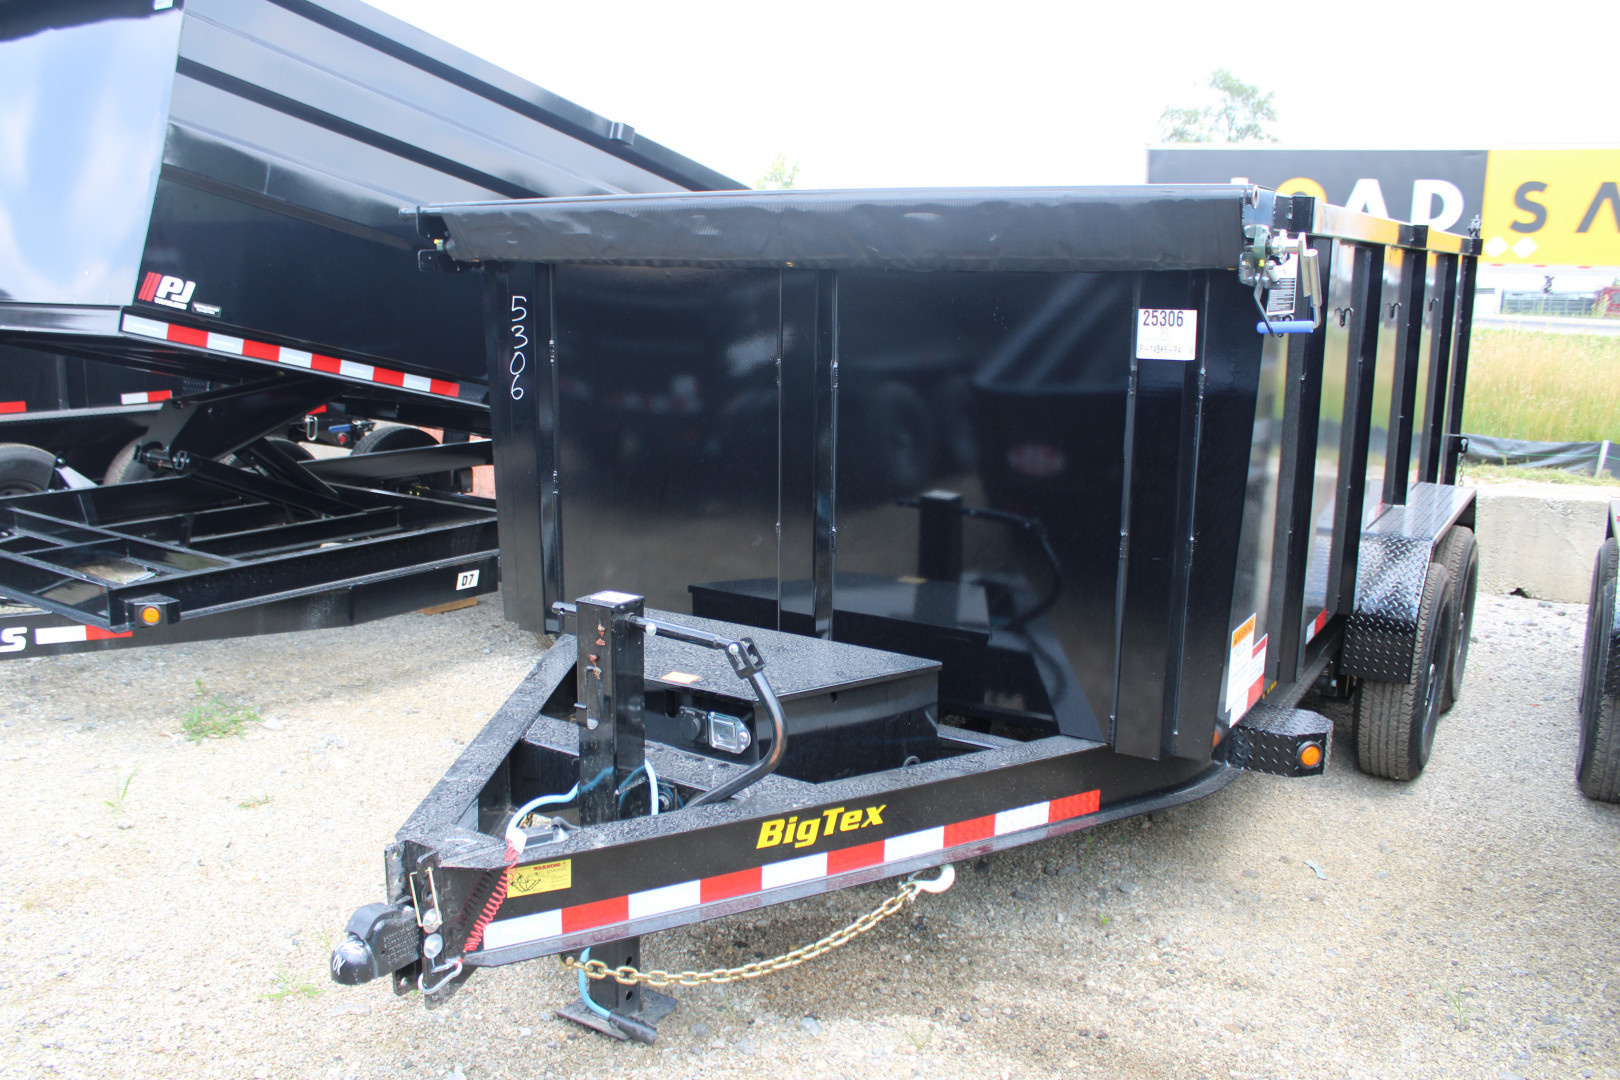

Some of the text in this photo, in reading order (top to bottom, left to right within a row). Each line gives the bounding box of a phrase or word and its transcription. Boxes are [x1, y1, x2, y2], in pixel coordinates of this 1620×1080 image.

[156, 275, 196, 304] PJ
[1142, 309, 1185, 328] 25306
[510, 295, 529, 401] 5306
[755, 803, 887, 850] BigTex
